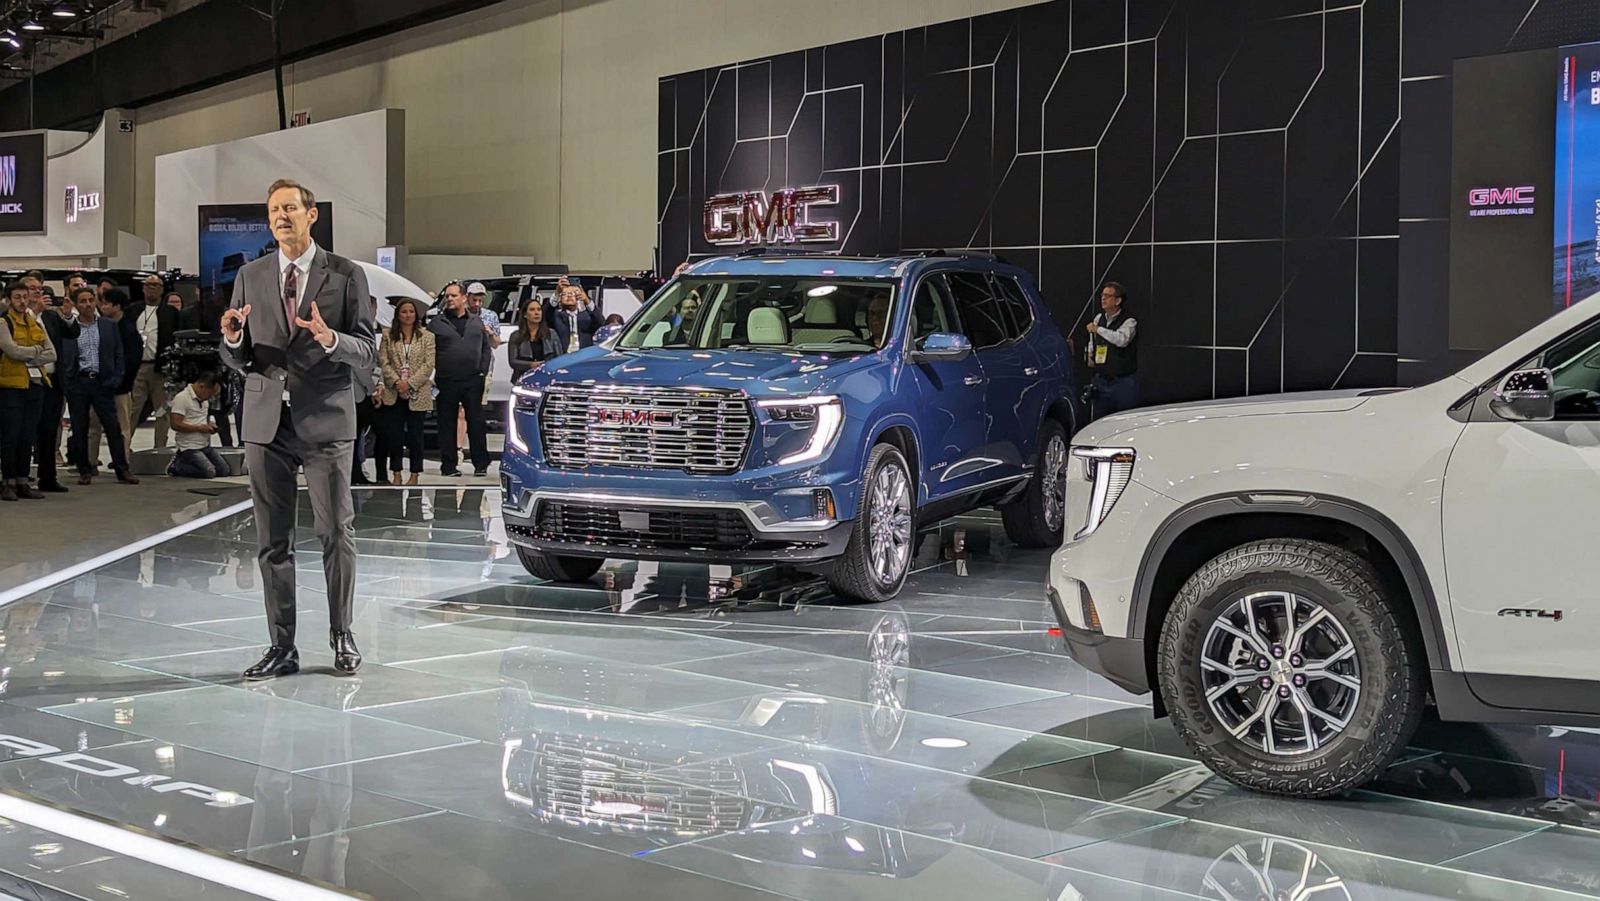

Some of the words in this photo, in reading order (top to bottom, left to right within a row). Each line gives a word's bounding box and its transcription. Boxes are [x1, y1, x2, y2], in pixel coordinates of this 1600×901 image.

[1469, 186, 1535, 206] GMC
[704, 185, 839, 245] GMC
[600, 409, 673, 427] GMC
[1498, 608, 1562, 622] AT4
[1269, 758, 1327, 772] TERRITORY
